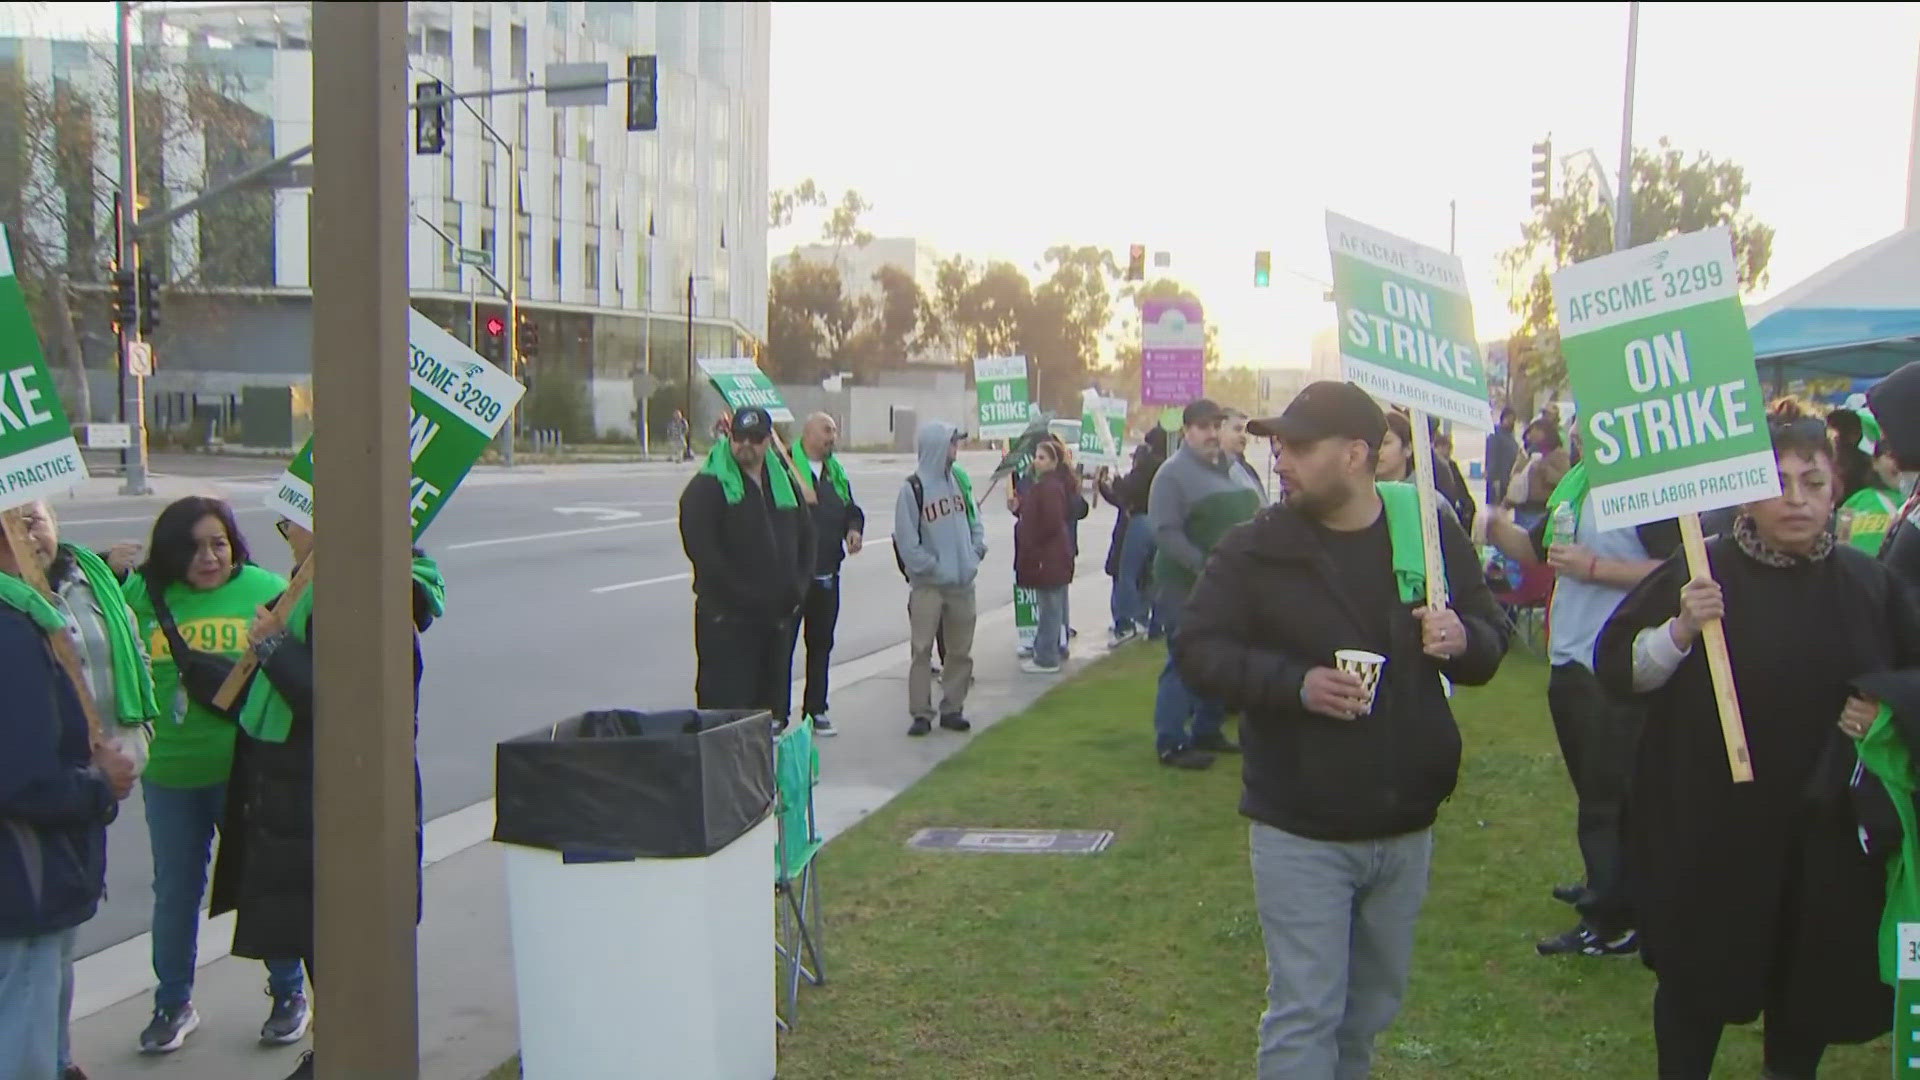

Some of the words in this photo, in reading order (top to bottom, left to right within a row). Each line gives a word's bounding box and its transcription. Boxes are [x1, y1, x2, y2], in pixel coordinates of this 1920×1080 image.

[1381, 280, 1432, 329] ON
[1569, 278, 1657, 323] AFSCME
[1662, 261, 1723, 298] 3299
[1347, 308, 1476, 386] STRIKE
[1624, 330, 1691, 393] ON
[410, 344, 460, 395] SCME
[454, 382, 502, 424] 3299
[993, 382, 1012, 402] ON
[1349, 367, 1390, 391] UNFAIR
[1392, 381, 1431, 403] LABOR
[1432, 393, 1484, 420] PRACTICE
[981, 401, 1027, 422] STRIKE
[1589, 379, 1754, 466] STRIKE
[8, 454, 76, 489] PRACTICE
[1602, 490, 1650, 516] UNFAIR
[1653, 482, 1698, 507] LABOR
[1700, 467, 1769, 495] PRACTICE
[162, 623, 238, 656] 299
